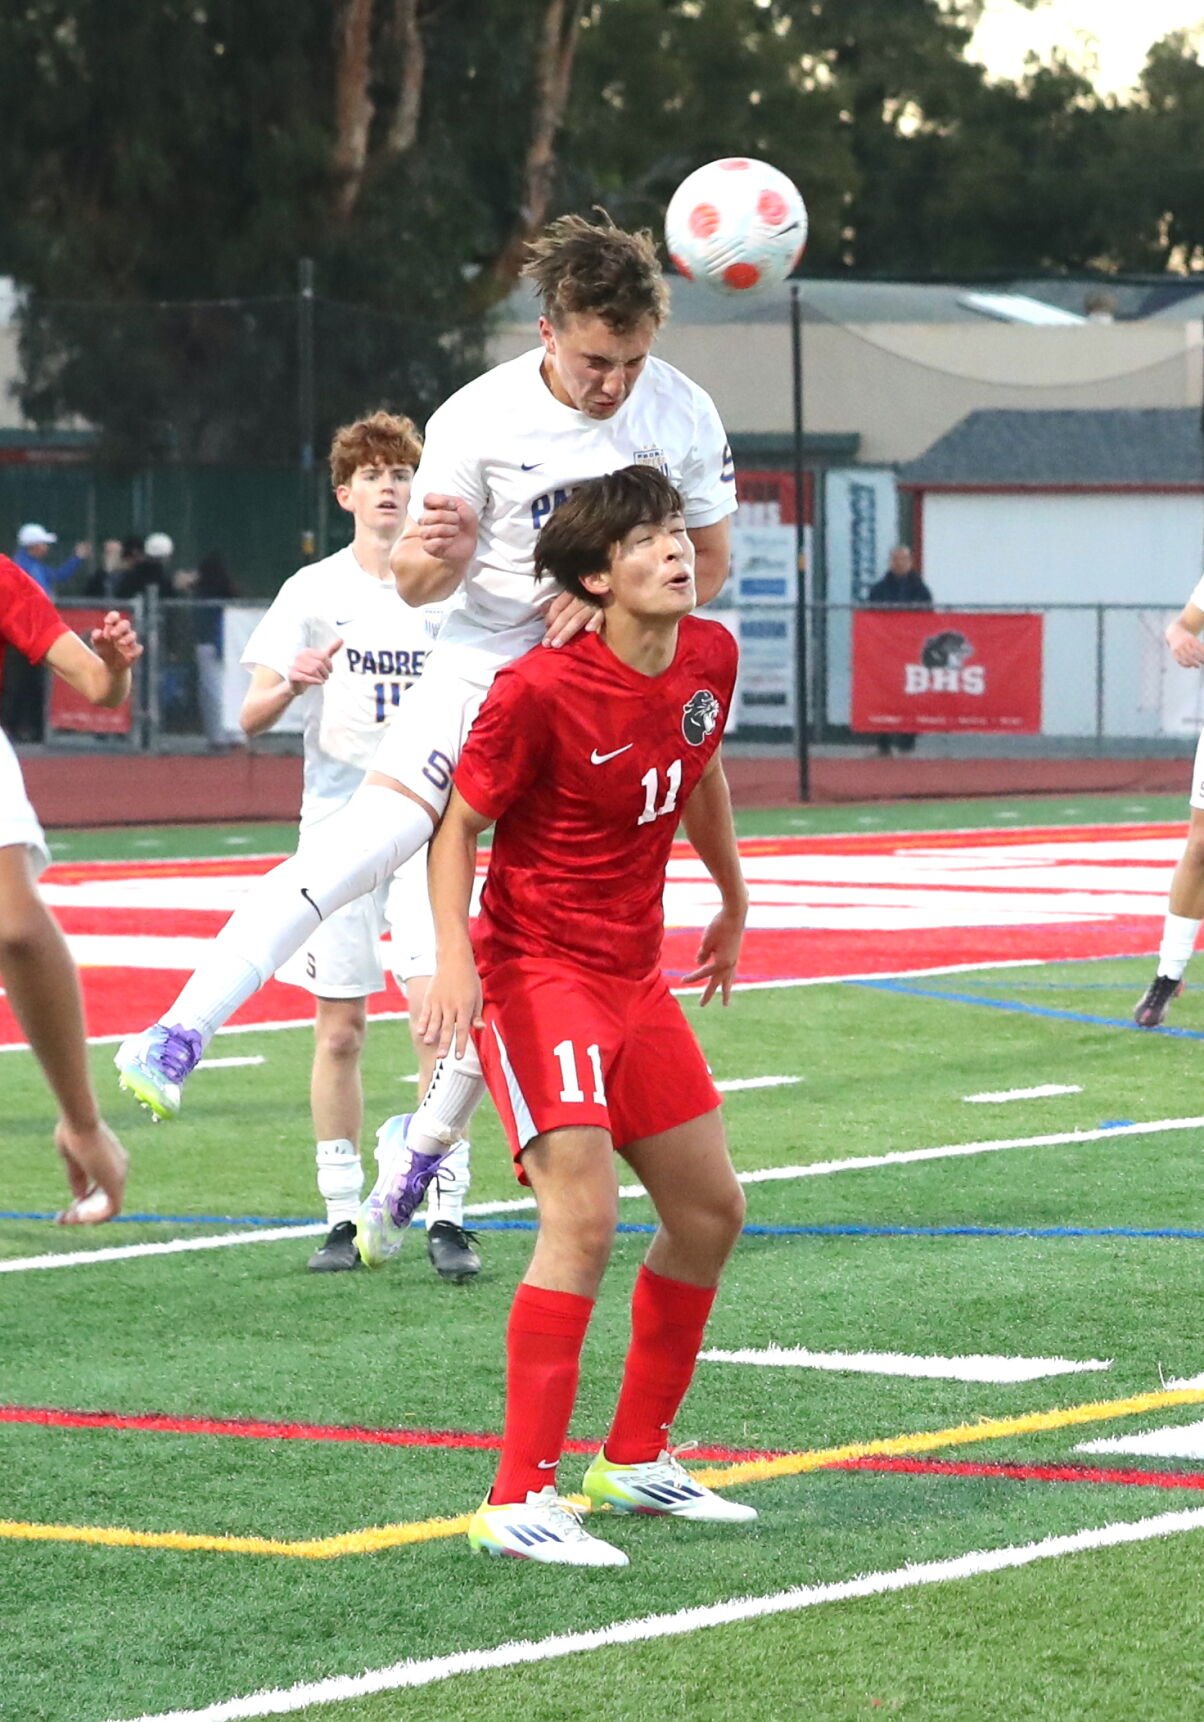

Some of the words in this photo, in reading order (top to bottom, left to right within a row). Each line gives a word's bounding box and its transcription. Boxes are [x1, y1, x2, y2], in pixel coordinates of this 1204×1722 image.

[346, 648, 428, 677] PADRE
[904, 664, 986, 695] BHS
[637, 759, 682, 826] 11
[306, 951, 317, 980] S
[553, 1040, 608, 1107] 11
